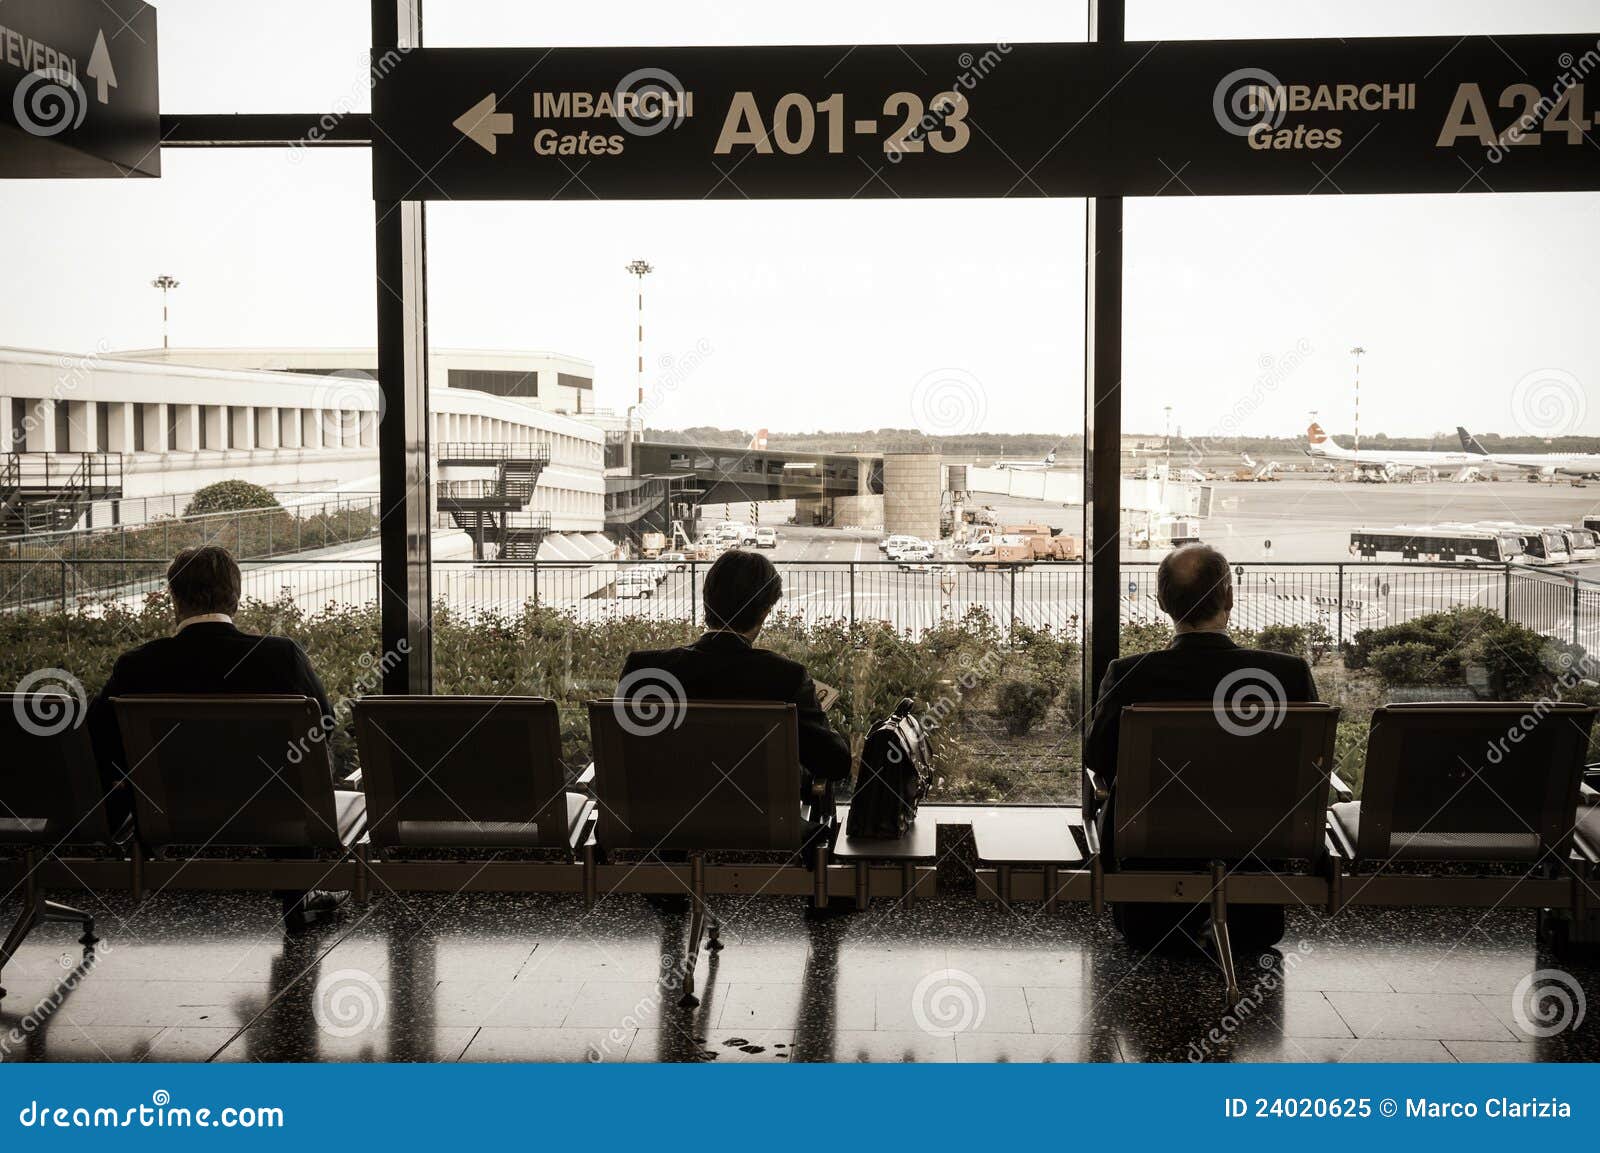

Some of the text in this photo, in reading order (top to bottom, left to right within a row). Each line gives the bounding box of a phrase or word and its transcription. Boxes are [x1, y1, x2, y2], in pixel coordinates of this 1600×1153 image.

[533, 91, 693, 118] IMBARCHI
[1248, 83, 1415, 112] IMBARCHI
[713, 91, 971, 154] A01-23
[1435, 82, 1600, 147] A24
[533, 129, 625, 155] Gates
[1248, 122, 1343, 150] Gates
